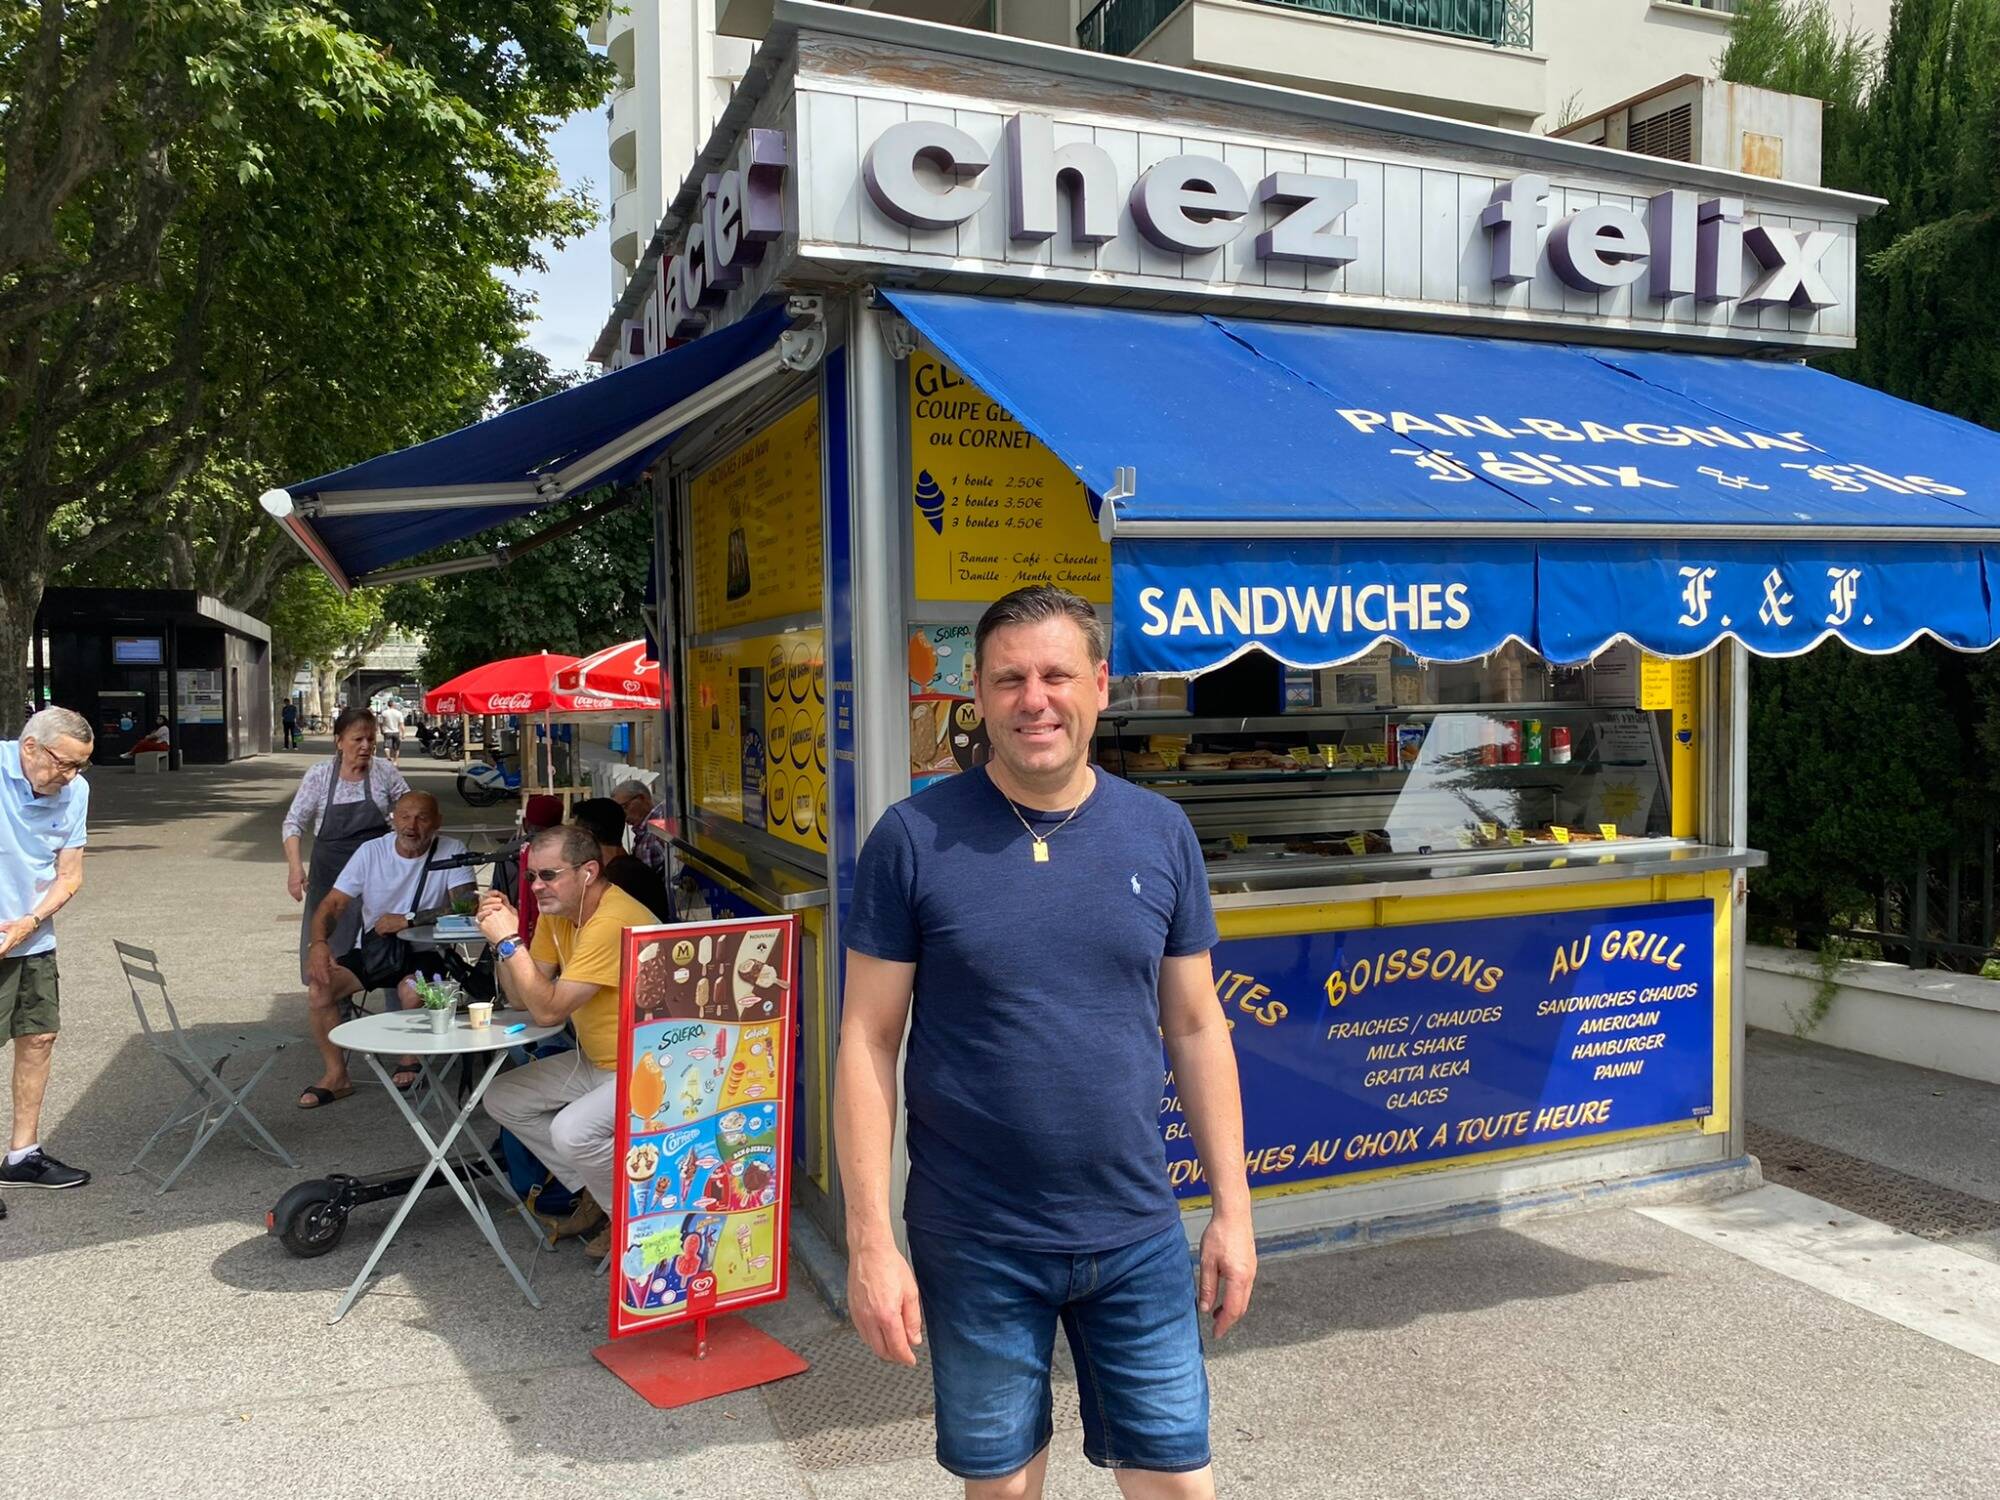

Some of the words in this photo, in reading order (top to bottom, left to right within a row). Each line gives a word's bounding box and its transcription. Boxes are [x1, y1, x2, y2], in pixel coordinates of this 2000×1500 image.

[863, 111, 1357, 268] chez
[1483, 174, 1840, 310] felix
[916, 400, 981, 422] COUPE
[930, 431, 953, 447] ou
[958, 428, 1033, 449] CORNET
[1335, 408, 1826, 453] PAN-BAGNAT
[951, 475, 958, 486] 1
[964, 473, 994, 487] boule
[951, 496, 959, 507] 2
[965, 495, 999, 508] boules
[951, 516, 959, 528] 3
[965, 515, 1000, 528] boules
[959, 551, 999, 564] Banane
[1012, 551, 1040, 566] Café
[1054, 552, 1098, 565] Chocolat
[958, 568, 1000, 581] Vanille
[1012, 569, 1053, 583] Menthe
[1056, 569, 1101, 582] Chocolat
[1139, 582, 1471, 636] SANDWICHES
[1758, 567, 1794, 627] &
[1549, 934, 1591, 984] AU
[1601, 929, 1686, 971] GRILL
[1323, 947, 1504, 1007] BOISSONS
[1537, 990, 1636, 1017] SANDWICHES
[1639, 982, 1698, 1003] CHAUDS
[1327, 1016, 1409, 1040] FRAICHES
[1426, 1006, 1502, 1030] CHAUDES
[1577, 1010, 1660, 1035] AMERICAIN
[658, 1024, 704, 1051] SOLERO
[1366, 1042, 1410, 1062] MILK
[1412, 1035, 1467, 1056] SHAKE
[1571, 1033, 1666, 1060] HAMBURGER
[1364, 1065, 1424, 1087] GRATTA
[1429, 1059, 1470, 1079] KEKA
[1593, 1060, 1644, 1081] PANINI
[1386, 1087, 1448, 1110] GLACES
[1299, 1138, 1342, 1168] AU
[1344, 1127, 1424, 1161] CHOIX
[1428, 1123, 1447, 1150] A
[1456, 1110, 1531, 1145] TOUTE
[1533, 1099, 1613, 1133] HEURE
